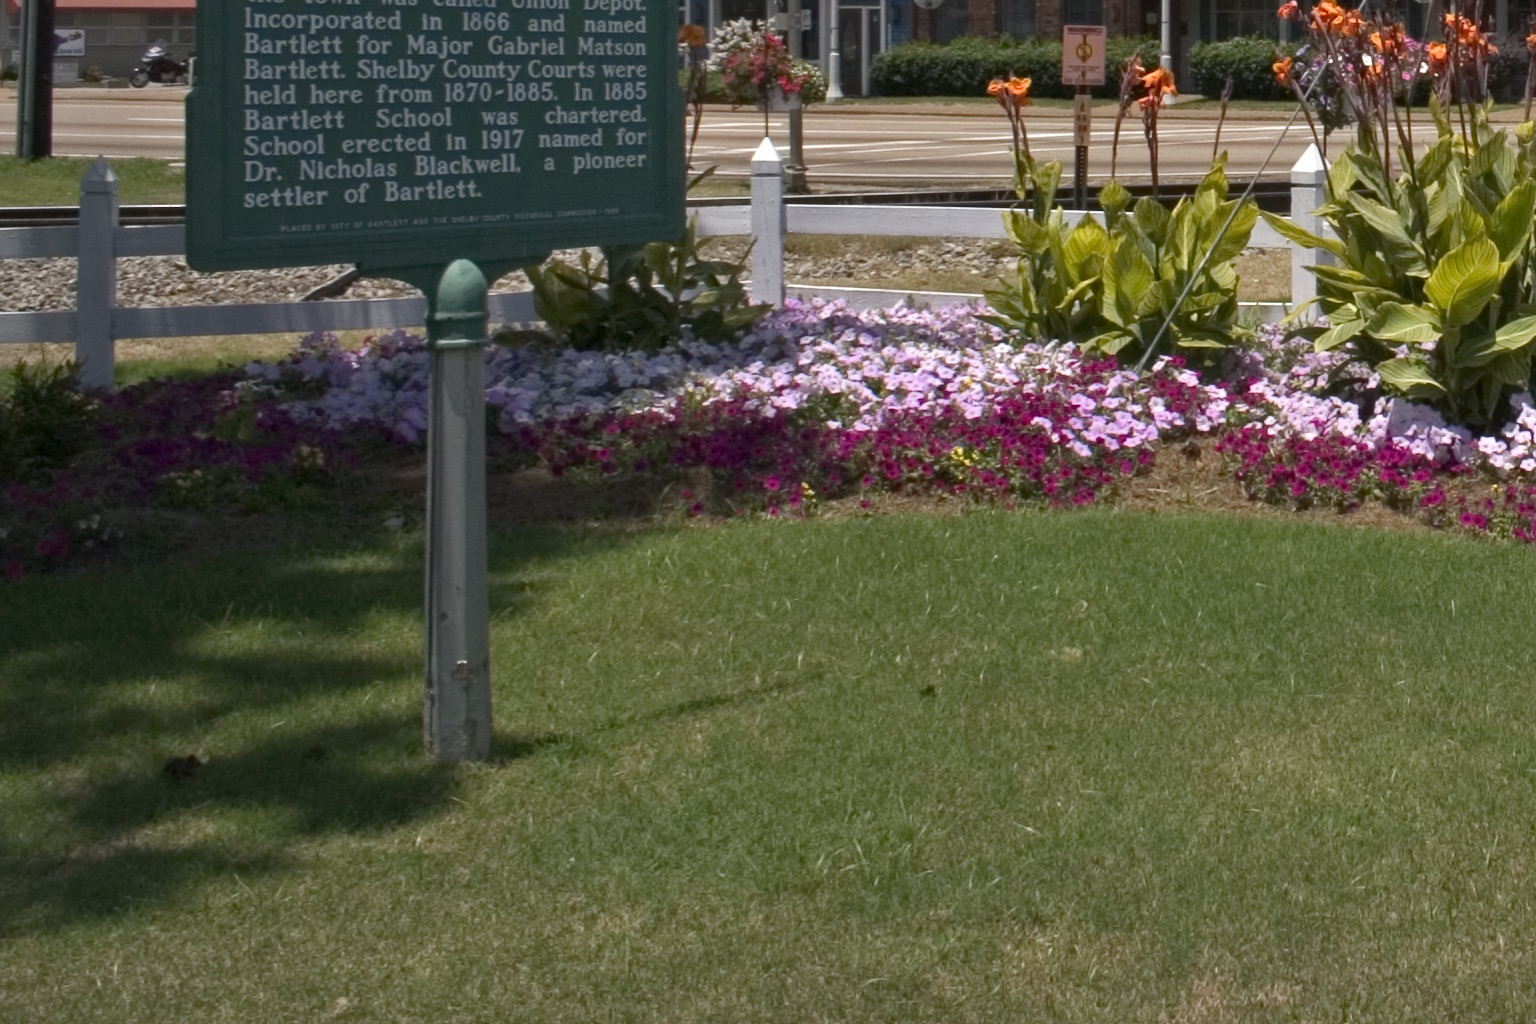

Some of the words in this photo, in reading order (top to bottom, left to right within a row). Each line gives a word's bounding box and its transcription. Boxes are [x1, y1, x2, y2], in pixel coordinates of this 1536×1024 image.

[245, 7, 401, 34] Incorporated
[422, 14, 442, 30] in
[463, 12, 509, 31] 1866
[528, 14, 564, 32] and
[584, 14, 646, 33] named
[244, 33, 342, 54] Bartlett
[357, 35, 392, 54] for
[407, 35, 472, 59] Major
[488, 36, 564, 55] Gabriel
[578, 37, 646, 55] Matson
[244, 58, 345, 79] Bartlett.
[358, 59, 435, 81] Shelby
[443, 59, 520, 81] County
[528, 60, 594, 78] Courts
[602, 65, 646, 78] were
[245, 84, 296, 104] held
[310, 84, 362, 104] here
[376, 84, 432, 103] from
[574, 83, 592, 100] In
[605, 82, 646, 100] 1885
[244, 110, 344, 130] Bartlett
[377, 107, 452, 128] School
[482, 112, 518, 125] was
[545, 104, 646, 124] chartered.
[244, 134, 324, 156] School
[342, 132, 431, 153] erected
[447, 134, 466, 150] in
[482, 129, 524, 149] 1917
[538, 129, 602, 148] named
[616, 128, 646, 145] for
[244, 161, 282, 182] Dr.
[300, 158, 396, 179] Nicholas
[415, 154, 520, 176] Blackwell,
[544, 158, 554, 170] a
[574, 153, 646, 174] pioneer
[244, 186, 328, 208] settler
[344, 183, 369, 203] of
[385, 180, 481, 201] Bartlett.
